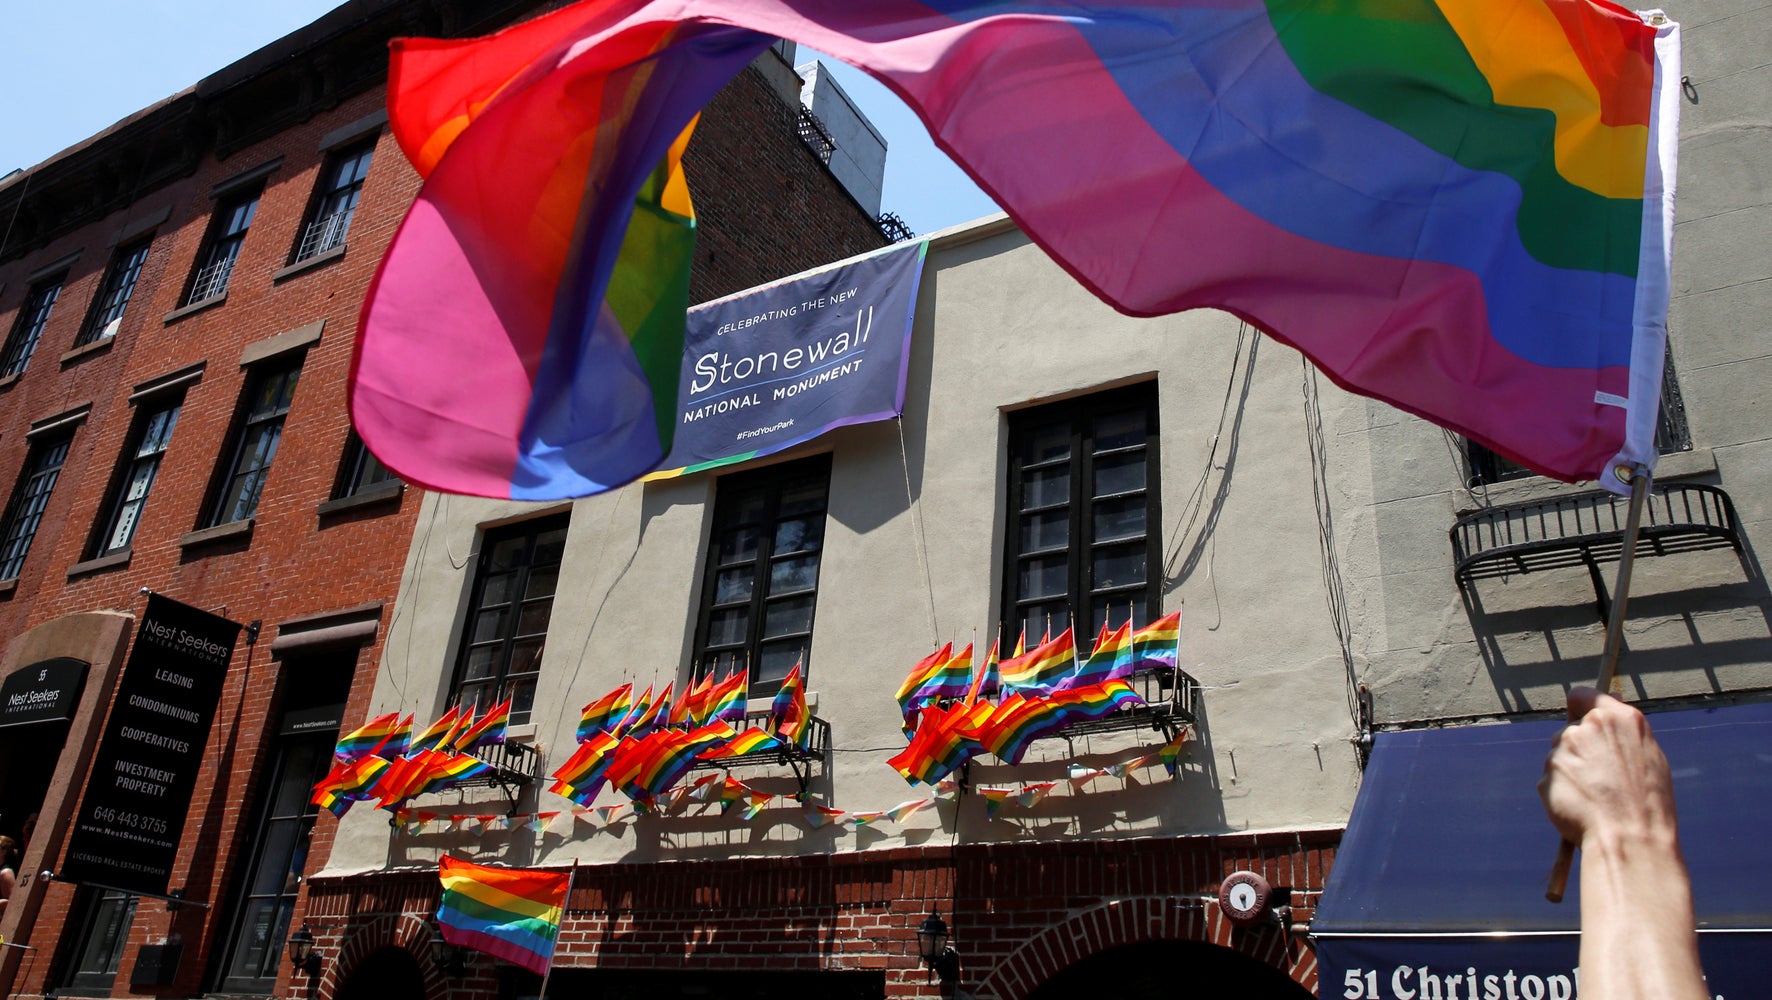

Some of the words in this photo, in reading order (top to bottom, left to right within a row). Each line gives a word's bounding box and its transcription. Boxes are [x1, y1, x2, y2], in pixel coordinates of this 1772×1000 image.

[717, 306, 797, 336] CELEBRATING
[801, 298, 826, 312] THE
[829, 287, 858, 304] NEW
[690, 305, 873, 395] Stonewall
[683, 393, 761, 423] NATIONAL
[773, 359, 863, 401] MONUMENT
[736, 418, 795, 441] #FindYourPark
[142, 634, 224, 666] INTERNATIONAL
[145, 619, 177, 640] Nest
[177, 630, 228, 658] Seekers
[38, 669, 48, 682] 55
[155, 668, 194, 689] LEASING
[5, 702, 55, 714] INTERNATIONAL
[8, 691, 29, 707] Nest
[27, 689, 60, 704] Seekers
[129, 694, 200, 724] CONDOMINIUMS
[121, 726, 190, 753] COOPERATIVES
[115, 760, 176, 784] INVESTMENT
[115, 776, 167, 797] PROPERTY
[94, 806, 116, 823] 646
[117, 811, 139, 828] 443
[140, 816, 167, 834] 3755
[81, 824, 173, 848] www.NestSeekers.com
[73, 852, 102, 864] LICENSED
[103, 857, 118, 867] REAL
[120, 860, 142, 871] ESTATE
[143, 865, 165, 876] BROKER
[1343, 968, 1380, 1000] 51
